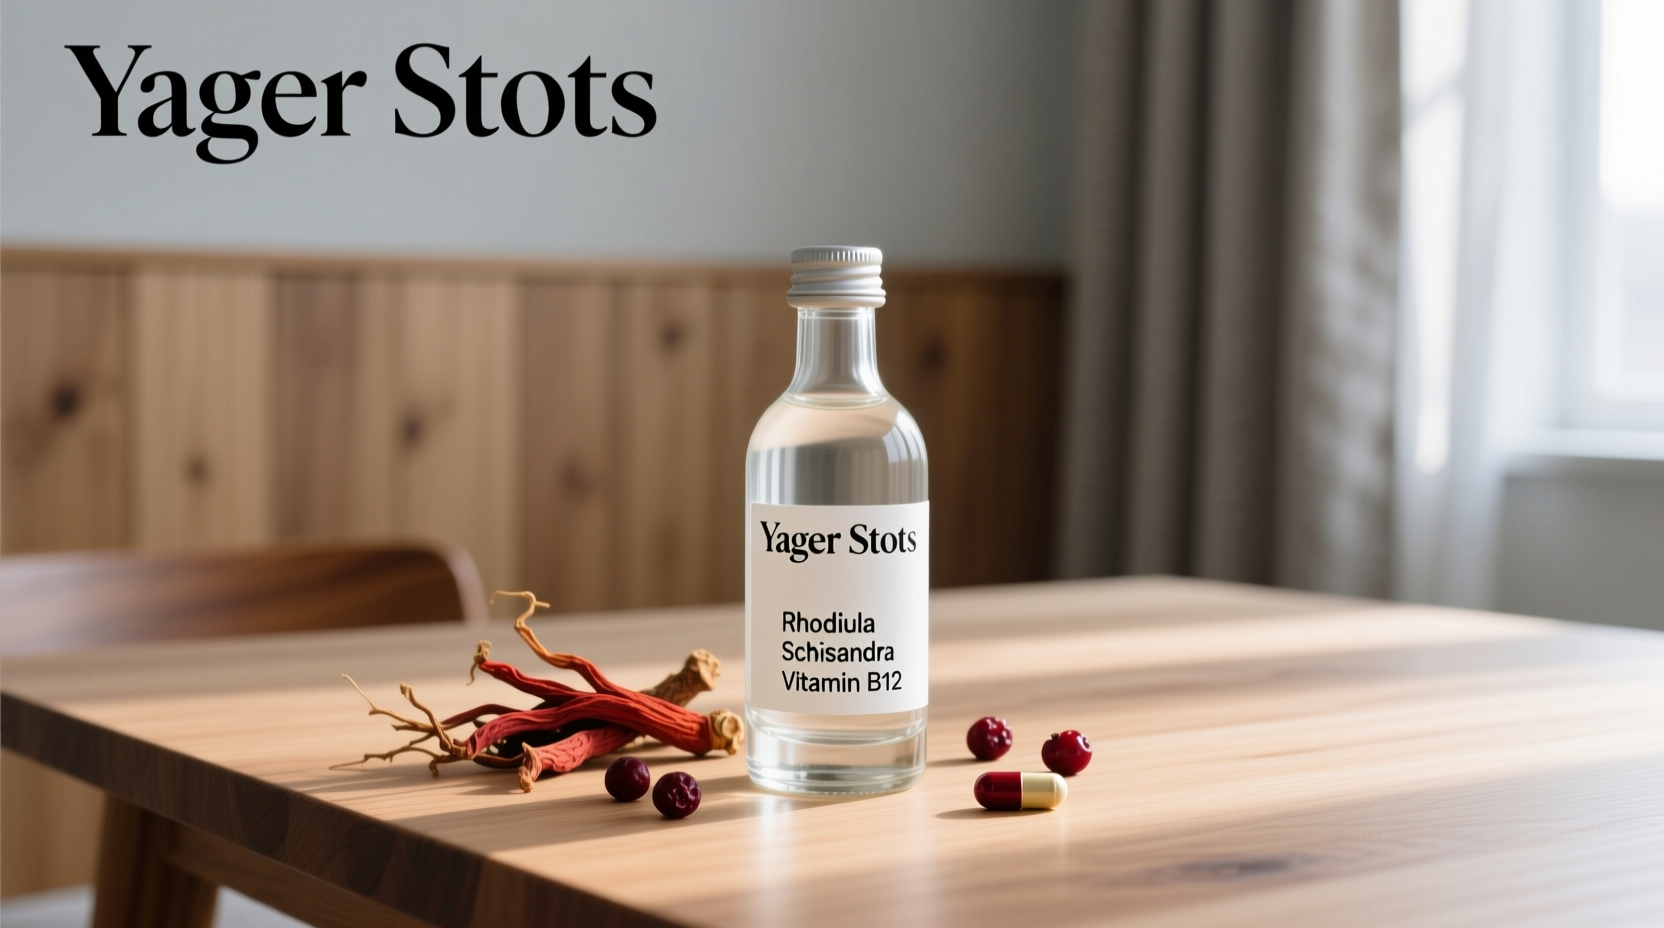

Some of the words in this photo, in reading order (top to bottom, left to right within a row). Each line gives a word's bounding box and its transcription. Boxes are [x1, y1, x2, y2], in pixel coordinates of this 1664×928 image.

[760, 521, 841, 563] Yager
[849, 523, 917, 554] Stots
[782, 611, 875, 633] Rhodiula
[782, 641, 895, 662] Schisandra
[781, 671, 860, 692] Vitamin
[867, 671, 902, 692] B12
